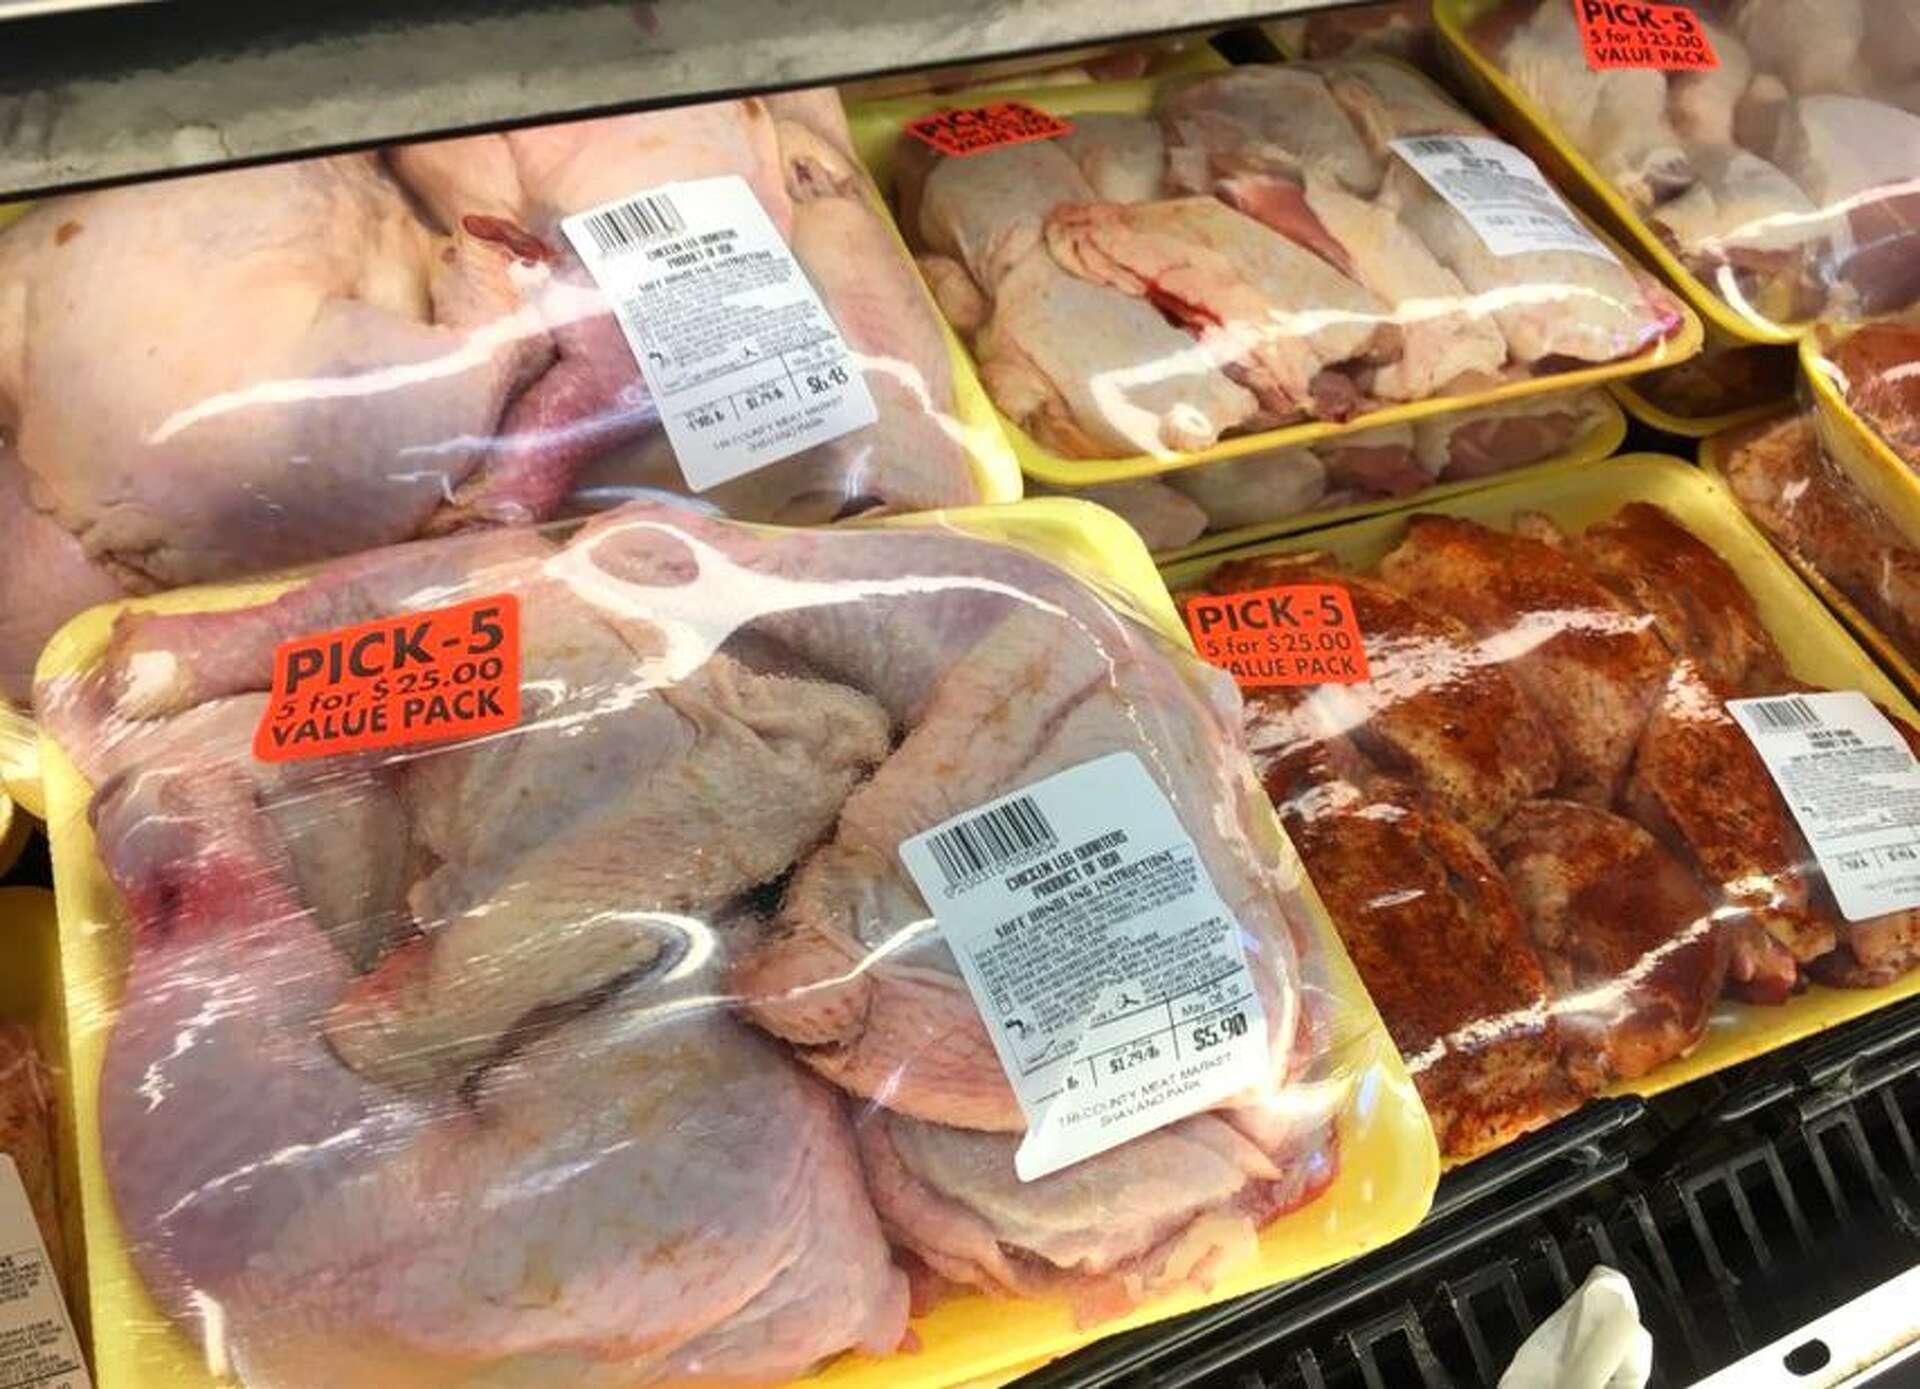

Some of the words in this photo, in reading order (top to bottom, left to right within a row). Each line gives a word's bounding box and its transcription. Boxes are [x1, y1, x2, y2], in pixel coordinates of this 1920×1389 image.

[1583, 0, 1694, 33] PICK-5
[1606, 28, 1631, 43] for
[1594, 48, 1652, 62] VALUE
[1659, 49, 1710, 64] PACK
[1197, 595, 1343, 634] PICK-5
[285, 608, 504, 695] PICK-5
[1226, 637, 1260, 654] for
[1267, 631, 1350, 653] $25.00
[1296, 656, 1358, 676] PACK
[276, 702, 295, 720] 5
[310, 689, 360, 713] for
[371, 657, 503, 701] $25.00
[271, 704, 388, 748] VALUE
[403, 686, 505, 729] PACK
[1193, 1012, 1248, 1051] $5.90
